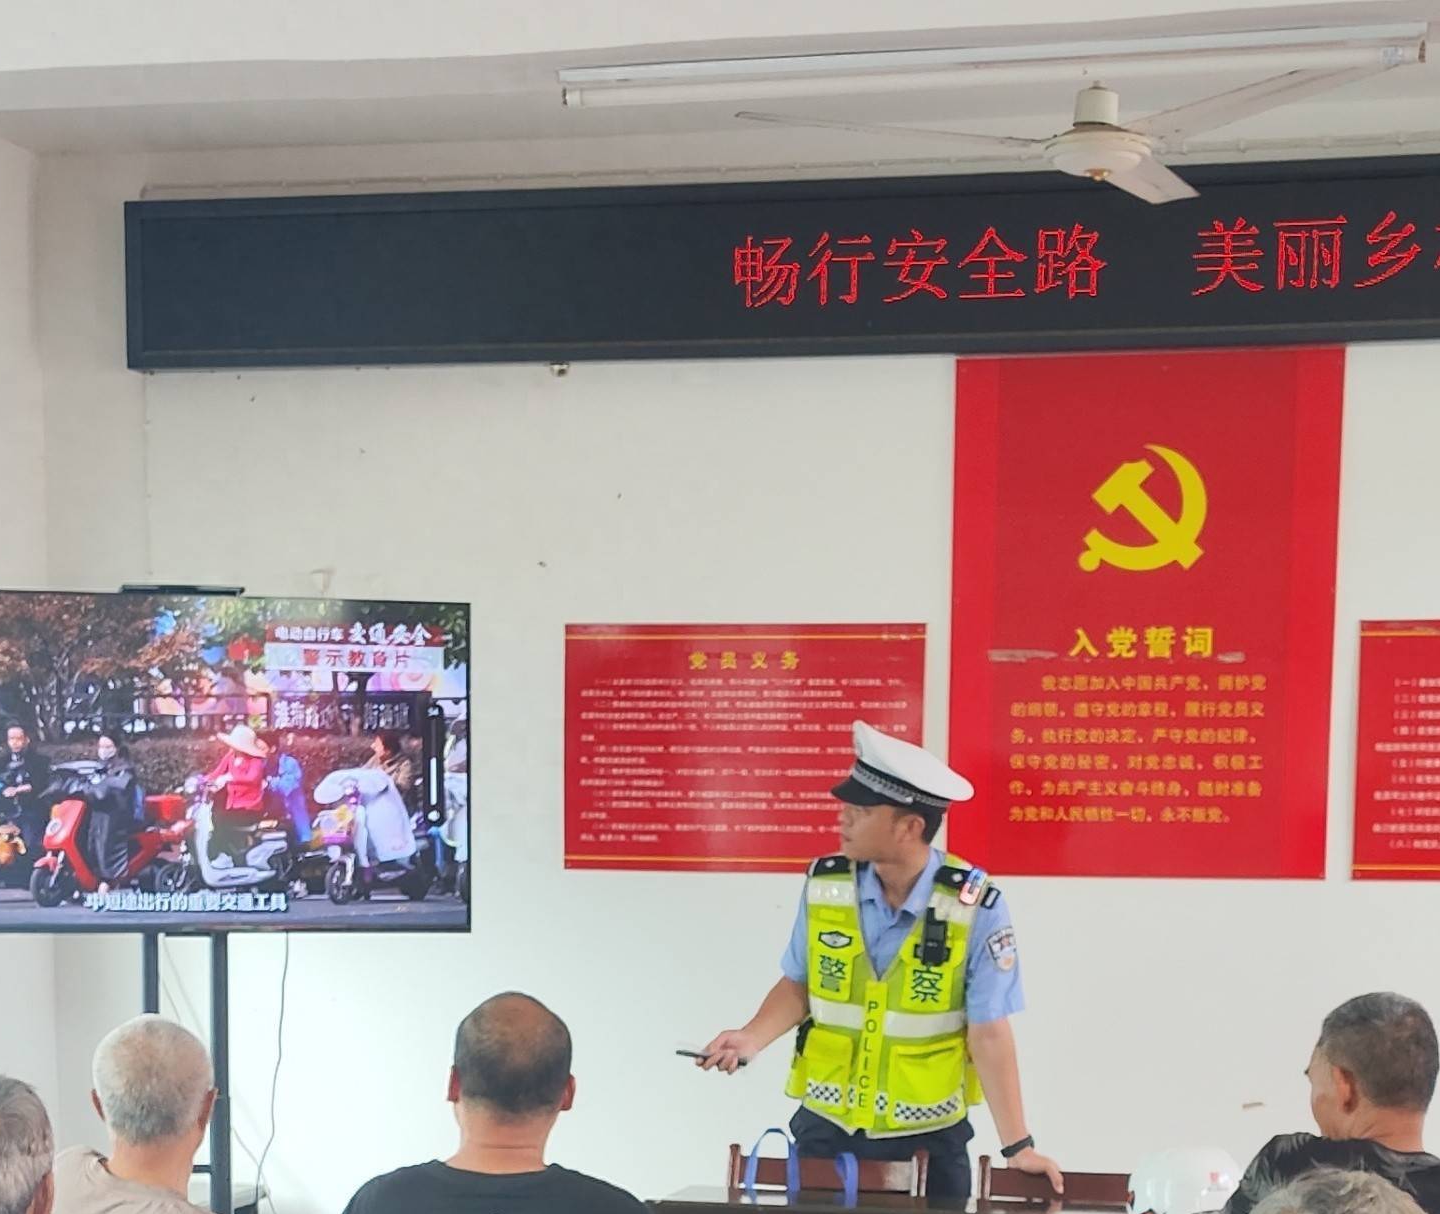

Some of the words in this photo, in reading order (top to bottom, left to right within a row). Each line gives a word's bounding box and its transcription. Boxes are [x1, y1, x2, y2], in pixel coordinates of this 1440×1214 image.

[731, 222, 1107, 308] 畅行安全路
[303, 649, 411, 668] 警示教育片
[688, 651, 799, 670] 党员义务
[1069, 626, 1213, 659] 入党誓词
[819, 955, 846, 992] 警
[911, 965, 944, 1003] 察
[858, 1000, 879, 1109] POLICE
